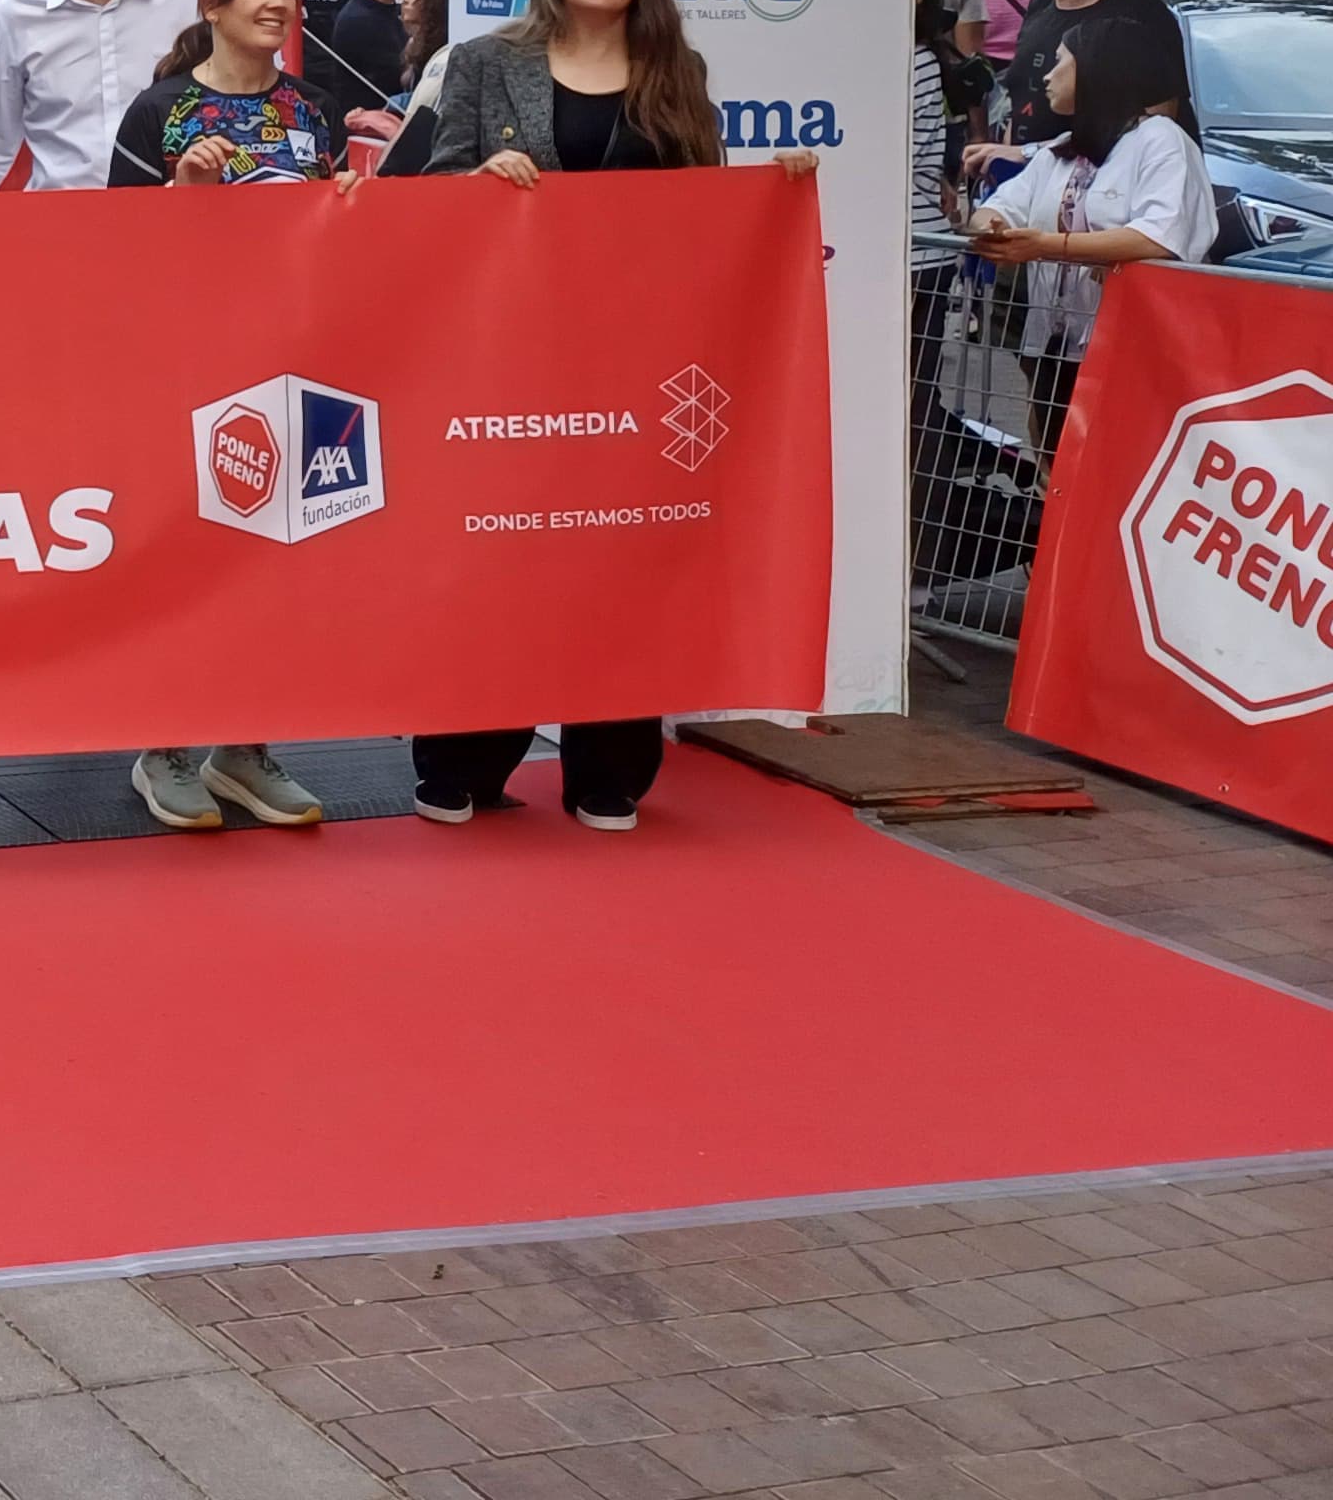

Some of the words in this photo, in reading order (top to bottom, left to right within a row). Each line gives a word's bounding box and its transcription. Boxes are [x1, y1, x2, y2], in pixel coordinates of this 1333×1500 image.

[697, 9, 747, 20] TALLERES
[445, 411, 639, 441] ATRESMEDIA
[218, 432, 270, 472] PONLE
[302, 446, 356, 489] AXA
[215, 451, 265, 491] FRENO
[302, 492, 371, 527] fundación
[465, 510, 544, 533] DONDE
[550, 507, 645, 529] ESTAMOS
[648, 501, 711, 523] TODOS
